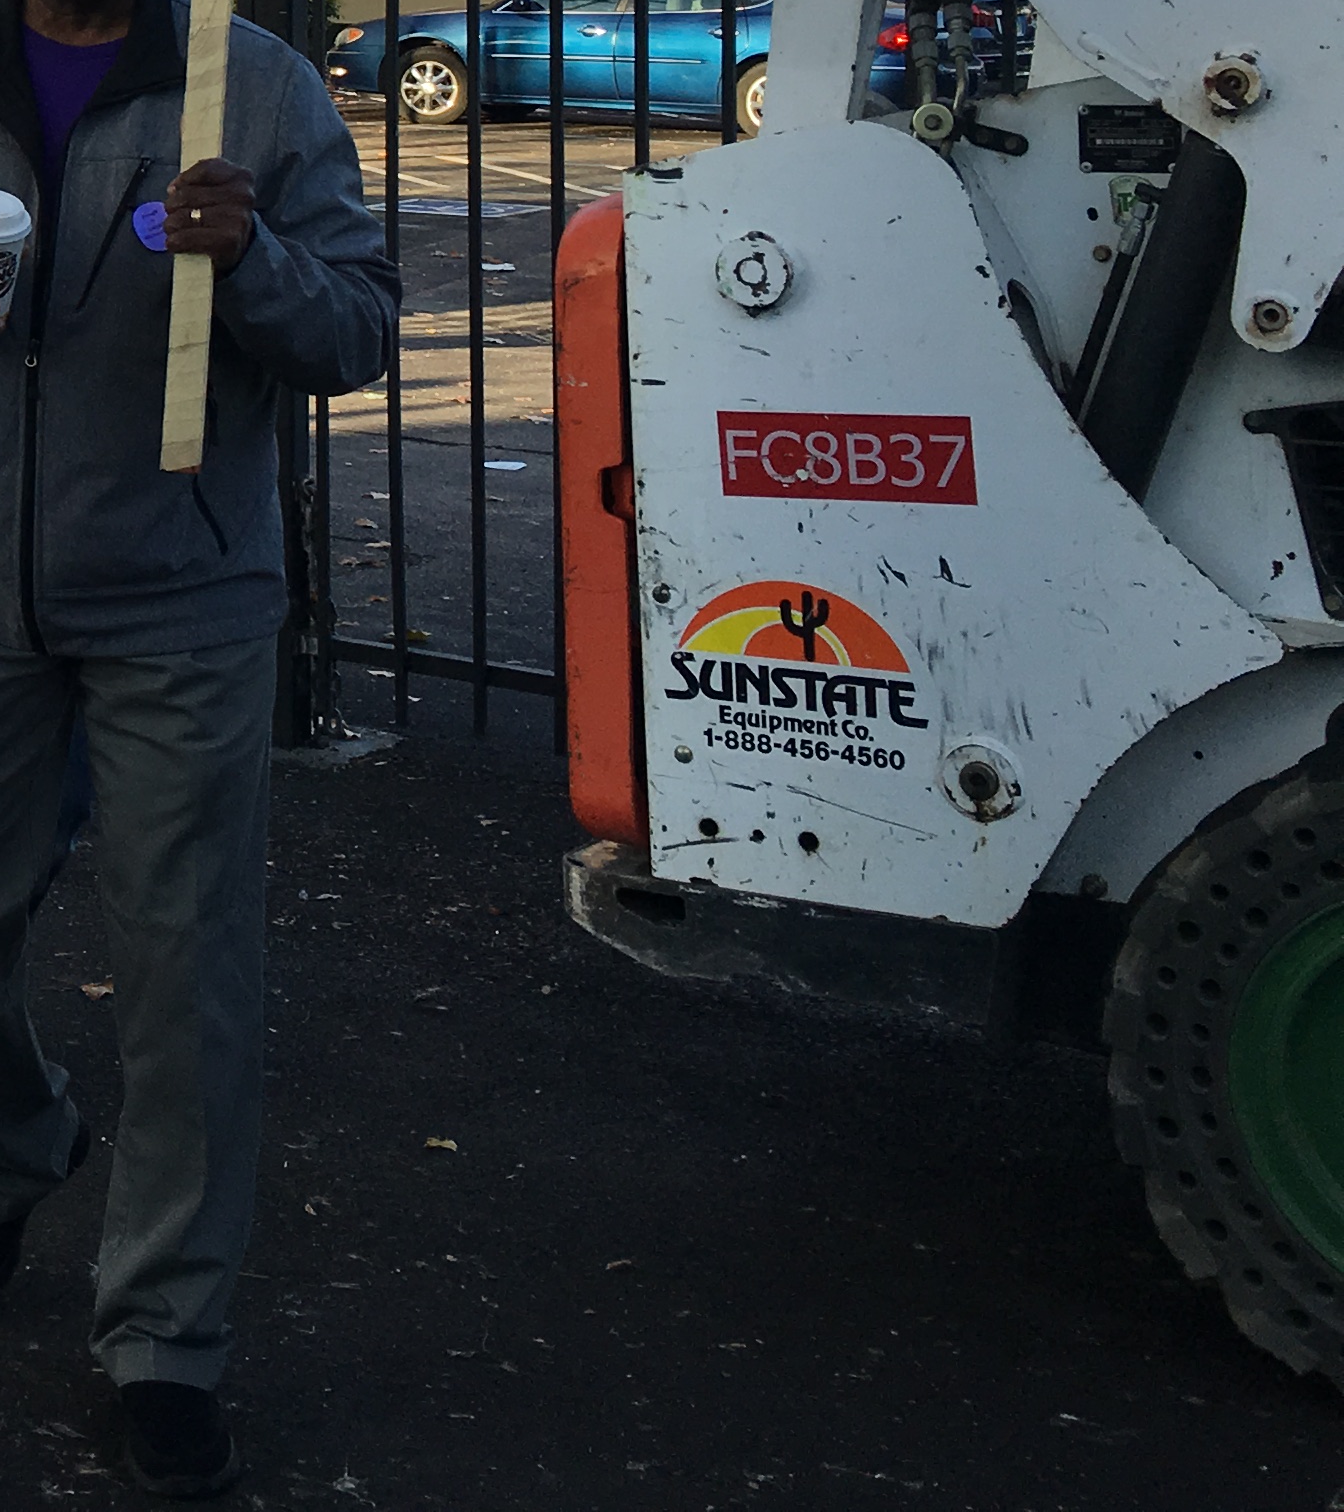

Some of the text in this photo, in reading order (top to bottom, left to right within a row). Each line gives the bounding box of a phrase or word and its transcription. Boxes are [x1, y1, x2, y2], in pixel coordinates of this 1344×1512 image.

[723, 428, 967, 489] FC8B37
[664, 650, 929, 730] SUNSTATE
[702, 727, 906, 771] 1-888-456-4560
[718, 704, 875, 743] Equipment Co.
